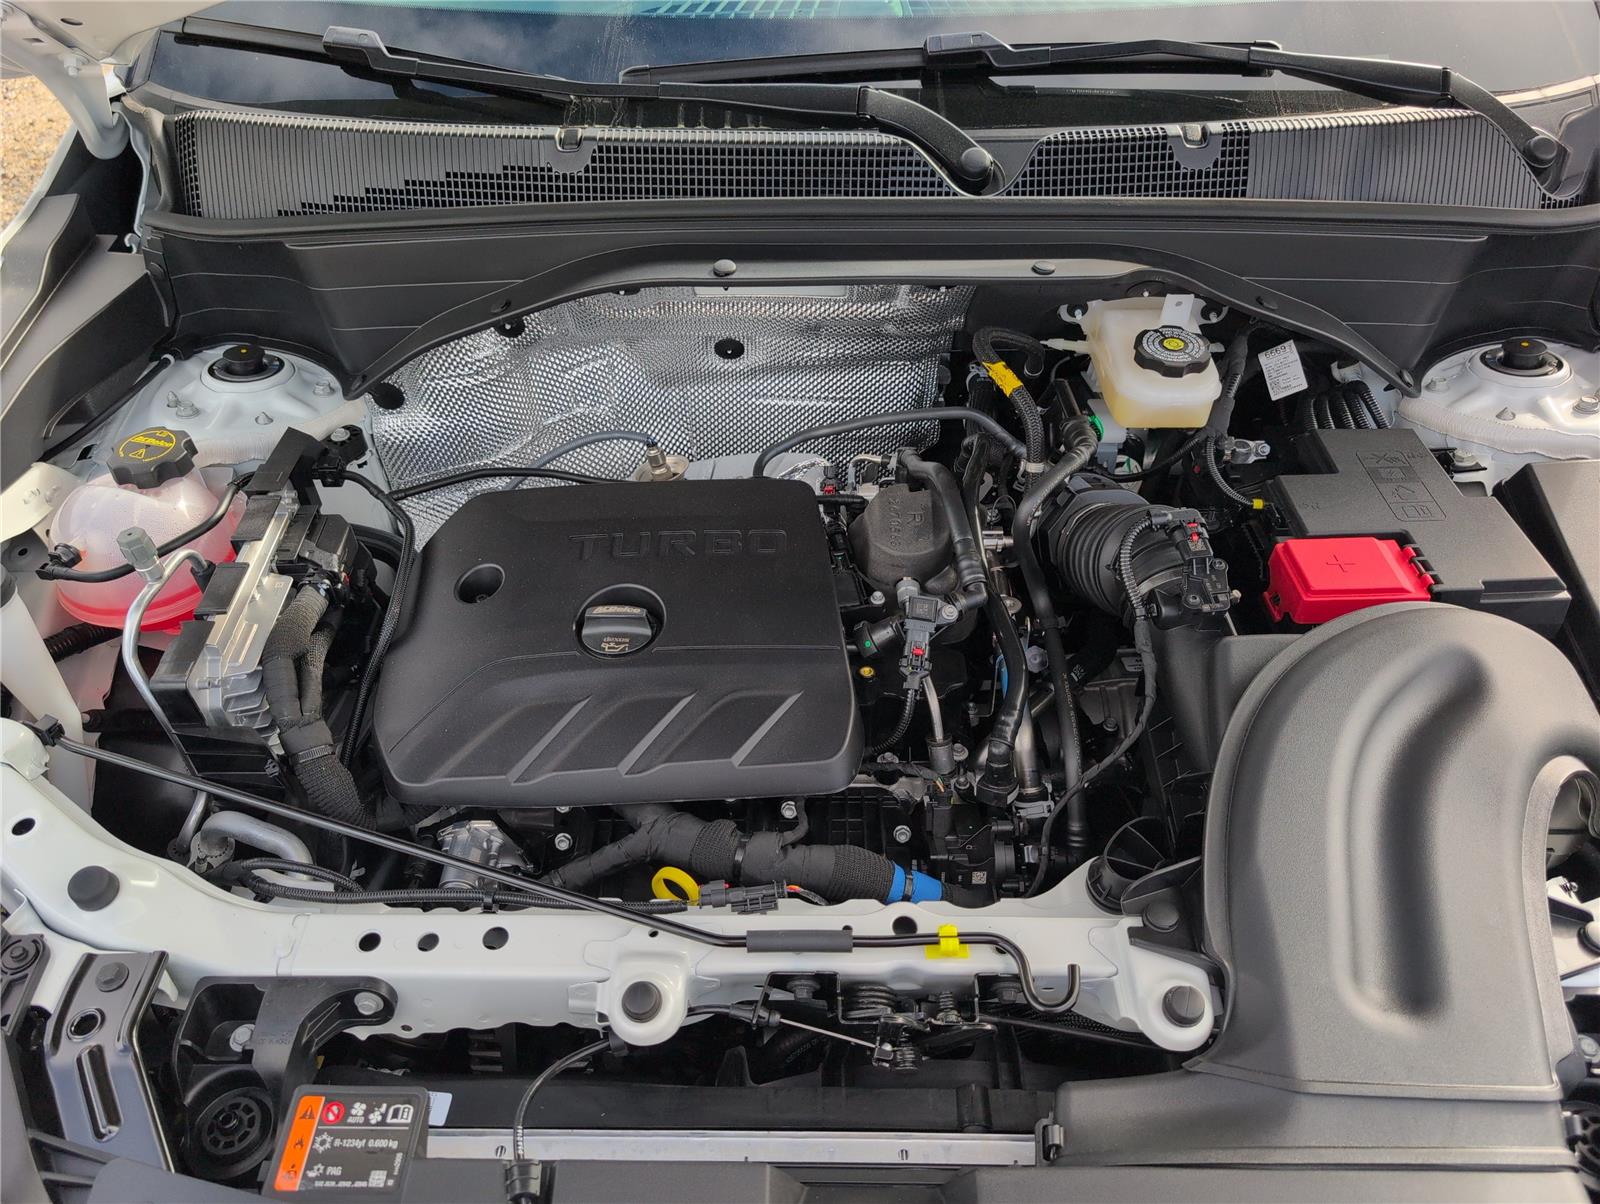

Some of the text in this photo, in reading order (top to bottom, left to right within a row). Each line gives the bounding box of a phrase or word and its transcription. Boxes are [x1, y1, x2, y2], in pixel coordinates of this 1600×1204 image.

[568, 530, 787, 560] TURBO
[333, 1138, 398, 1149] R-1234yf 0.600 kg
[326, 1166, 342, 1175] PAG
